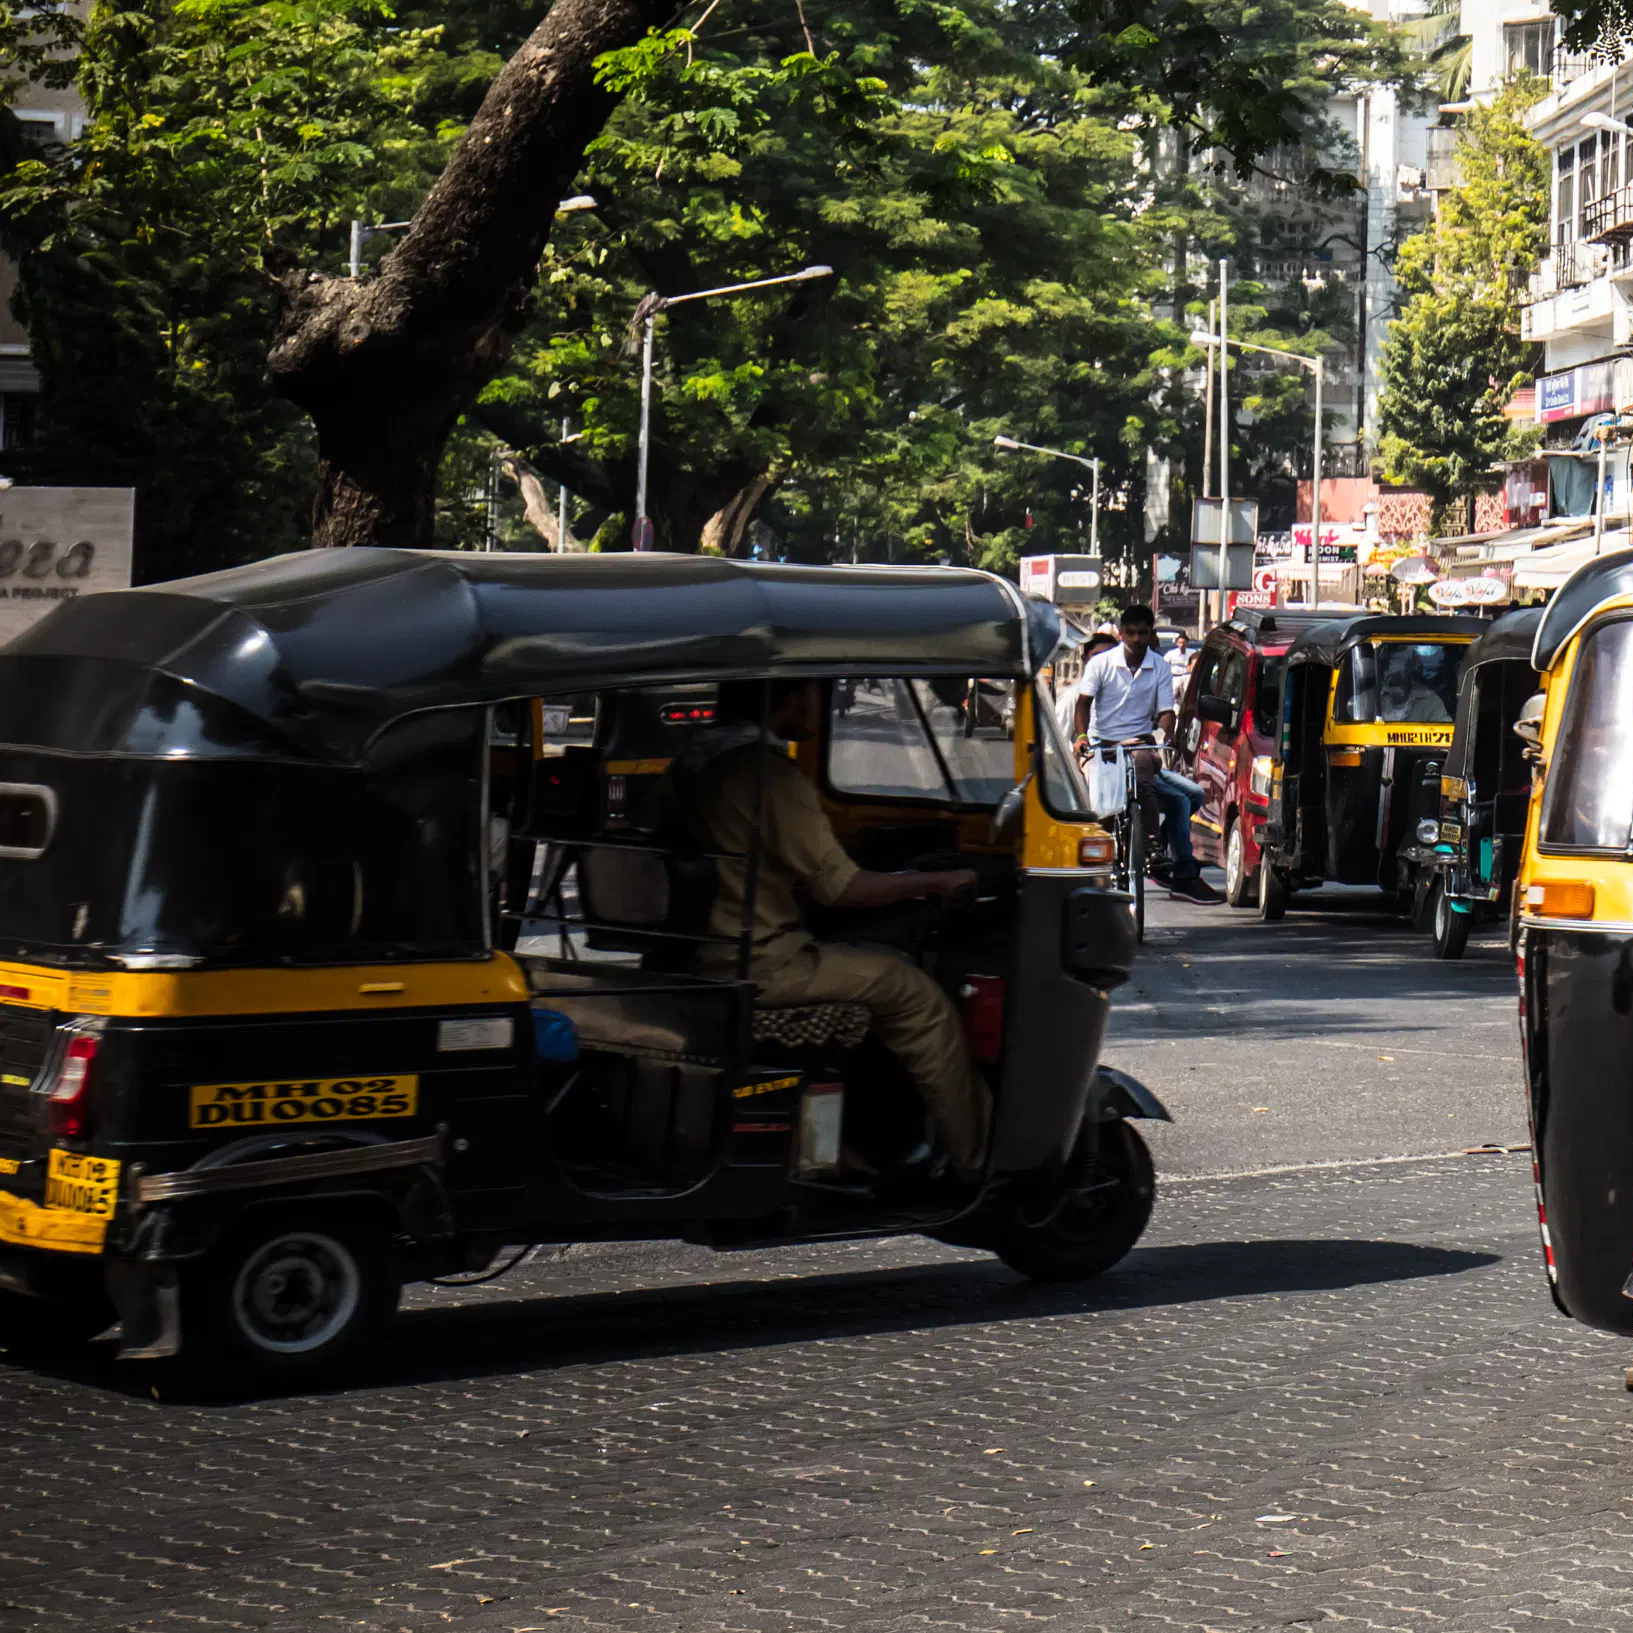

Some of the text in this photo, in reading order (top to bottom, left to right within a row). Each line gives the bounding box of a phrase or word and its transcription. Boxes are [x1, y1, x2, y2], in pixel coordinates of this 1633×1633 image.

[1062, 574, 1093, 584] BEST
[213, 1078, 399, 1103] MH 02
